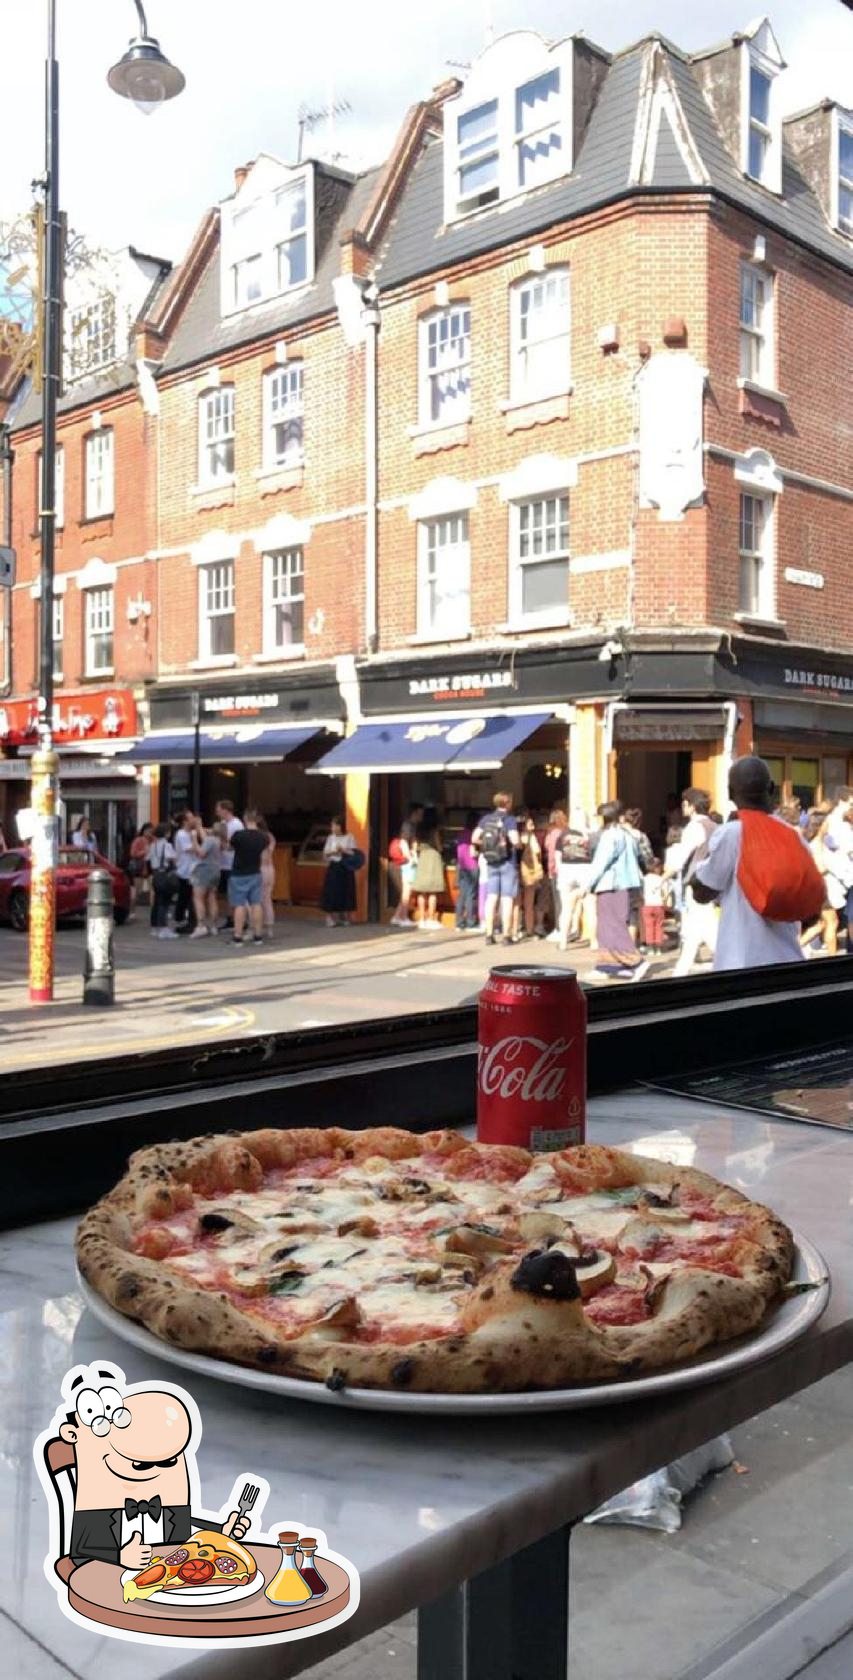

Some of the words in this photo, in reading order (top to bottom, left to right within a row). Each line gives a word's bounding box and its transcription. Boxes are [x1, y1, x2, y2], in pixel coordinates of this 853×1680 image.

[409, 678, 449, 694] DARK
[452, 672, 512, 690] SUGARS
[785, 668, 814, 685] DARK
[816, 673, 853, 690] SUGAR
[503, 983, 541, 996] TASTE
